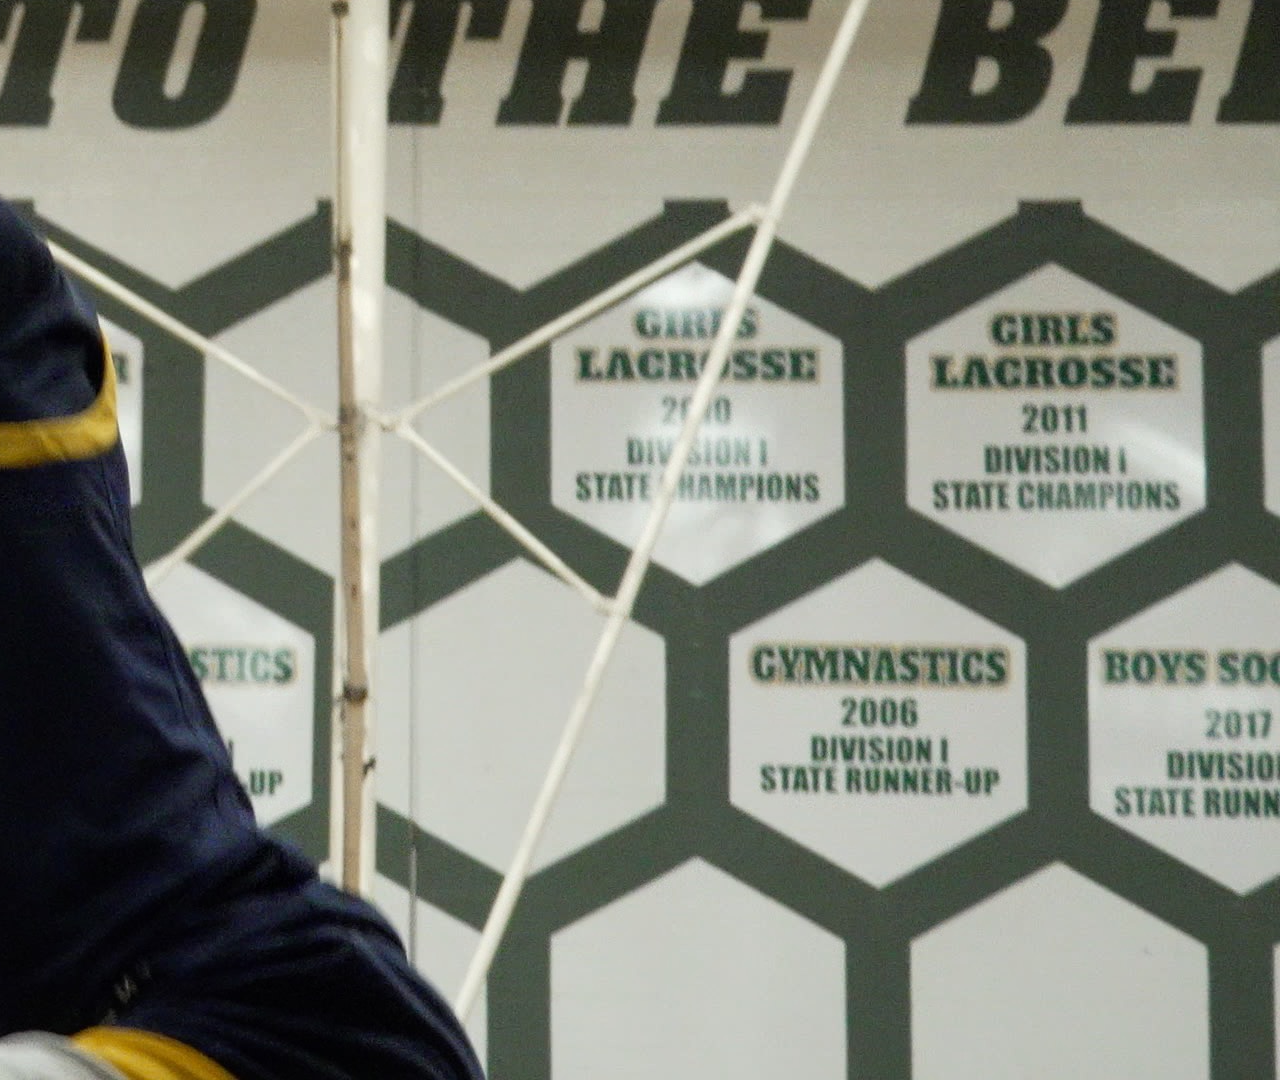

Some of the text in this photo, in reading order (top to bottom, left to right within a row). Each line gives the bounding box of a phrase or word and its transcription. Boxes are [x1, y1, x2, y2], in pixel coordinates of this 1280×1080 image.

[992, 312, 1115, 346] GIRLS
[932, 356, 1176, 389] LACROSSE
[1021, 402, 1087, 433] 2011
[628, 437, 750, 466] DIVSION
[984, 445, 1127, 475] DIVISION I
[575, 473, 820, 502] STATE HAMPIONS
[932, 481, 1180, 512] STATE CHAMPIONS
[752, 646, 1007, 686] GYMNASTICS
[1104, 651, 1206, 684] BOYS
[841, 697, 918, 728] 2006
[1205, 709, 1273, 740] 2017
[811, 735, 949, 764] DIVISION I
[760, 766, 1000, 796] STATE RUNNER-UP
[1167, 750, 1280, 781] DIVISIO
[1115, 786, 1280, 818] STATE RUNN
